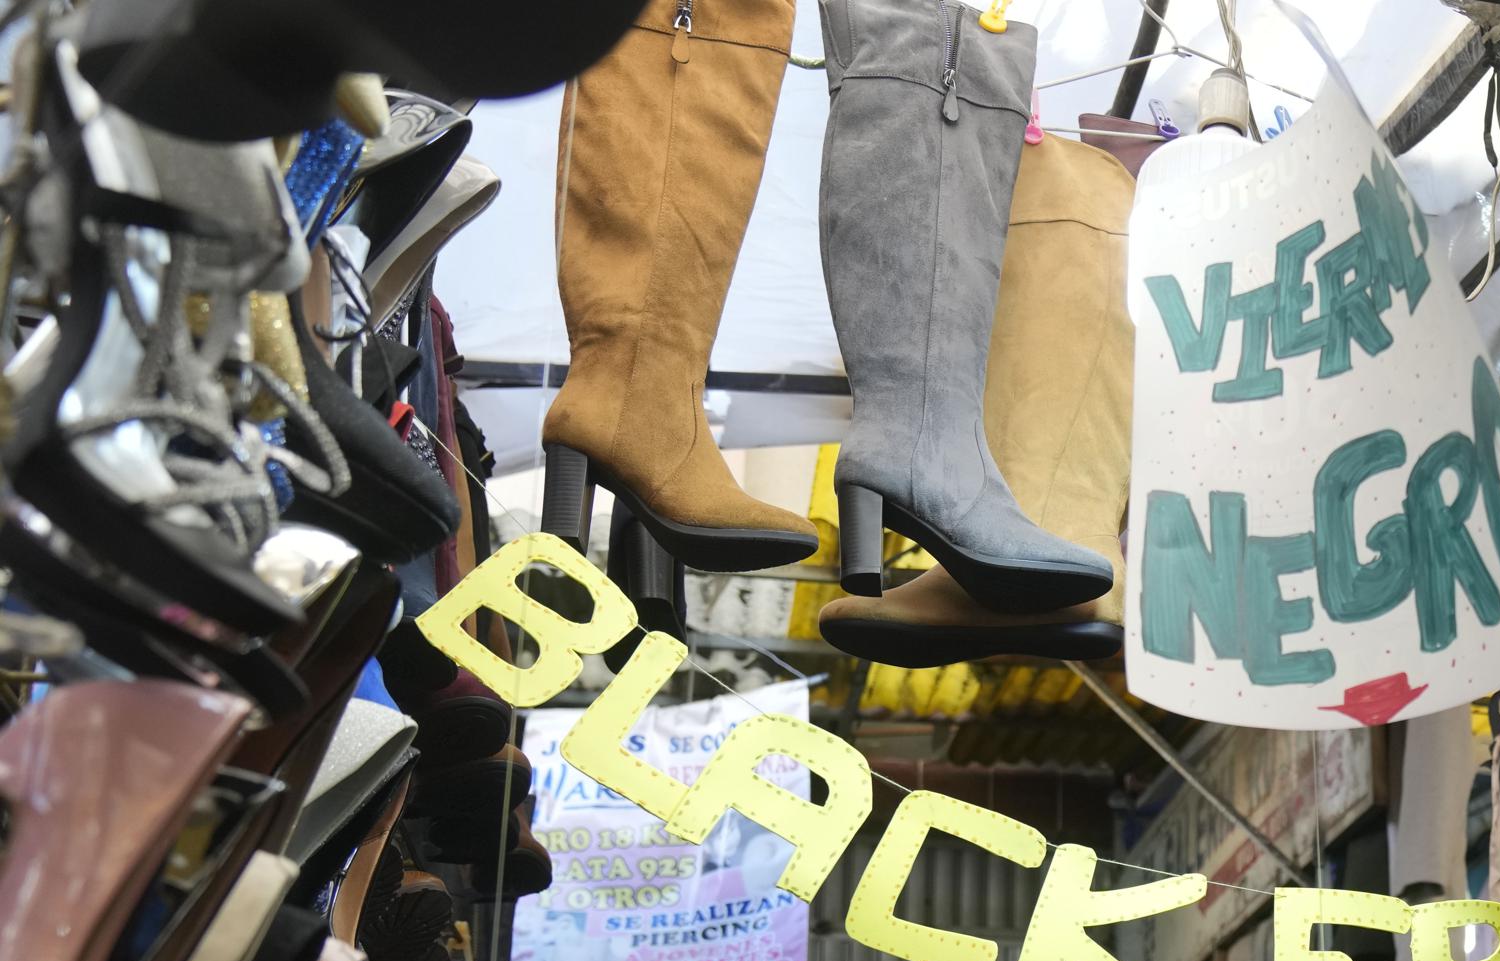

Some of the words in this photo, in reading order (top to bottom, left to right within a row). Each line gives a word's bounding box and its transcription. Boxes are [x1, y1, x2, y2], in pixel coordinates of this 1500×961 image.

[550, 855, 632, 883] LATA
[639, 854, 696, 880] 925
[567, 884, 681, 909] OTROS
[606, 916, 642, 931] SE
[651, 893, 793, 928] REALIZAN
[631, 915, 768, 948] PIERCING
